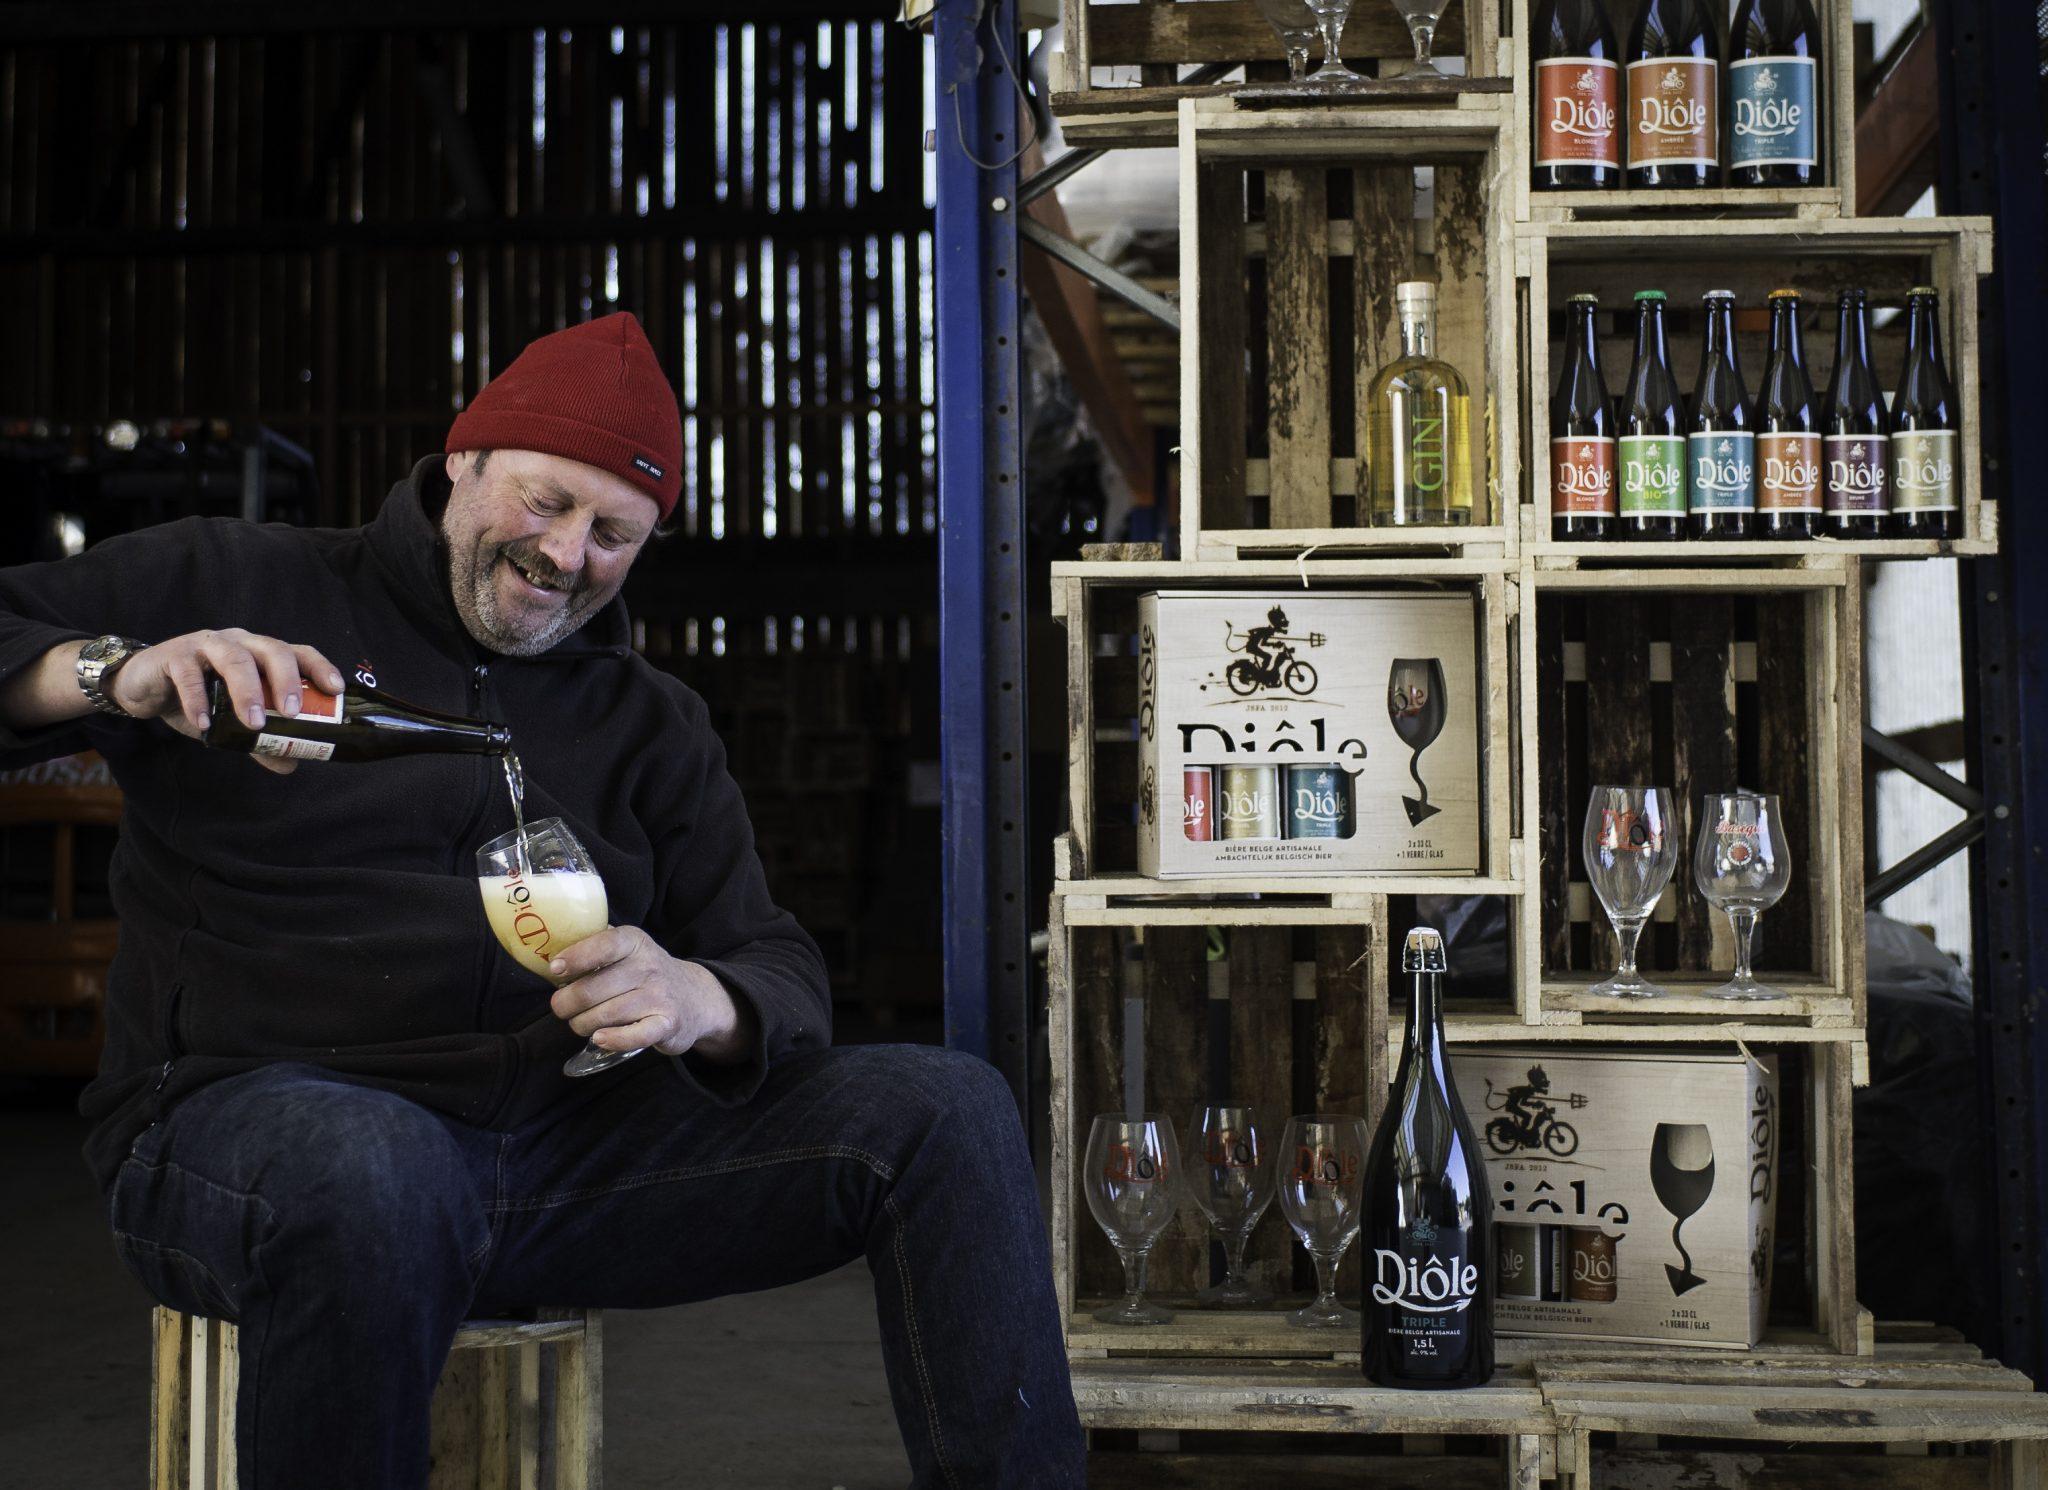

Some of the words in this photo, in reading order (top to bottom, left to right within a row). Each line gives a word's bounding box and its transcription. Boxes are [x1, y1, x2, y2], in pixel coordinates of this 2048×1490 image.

[1551, 96, 1615, 137] Diôle
[1639, 96, 1706, 135] Diôle
[1735, 97, 1801, 136] Diôle
[1412, 415, 1444, 491] GIN
[1558, 461, 1611, 497] Diôle
[1625, 460, 1681, 495] Diôle
[1696, 456, 1751, 491] Diôle
[1763, 456, 1818, 492] Diôle
[1828, 460, 1885, 495] Diôle
[1896, 457, 1952, 490] Diôle
[1643, 490, 1662, 500] BIO
[1407, 850, 1424, 859] VERRE
[1430, 850, 1444, 858] GLAS
[1751, 1084, 1775, 1205] Diôle
[1500, 1180, 1629, 1242] iôle
[1372, 1248, 1478, 1313] Diôle
[1401, 1316, 1447, 1328] TRIPLE
[1495, 1312, 1531, 1320] CHTELIJK
[1534, 1314, 1573, 1322] BELGISCH
[1534, 1305, 1583, 1315] ARTISANALE
[1670, 1320, 1689, 1329] VERRE
[1694, 1321, 1710, 1330] GLAS
[1413, 1339, 1427, 1349] 1,5
